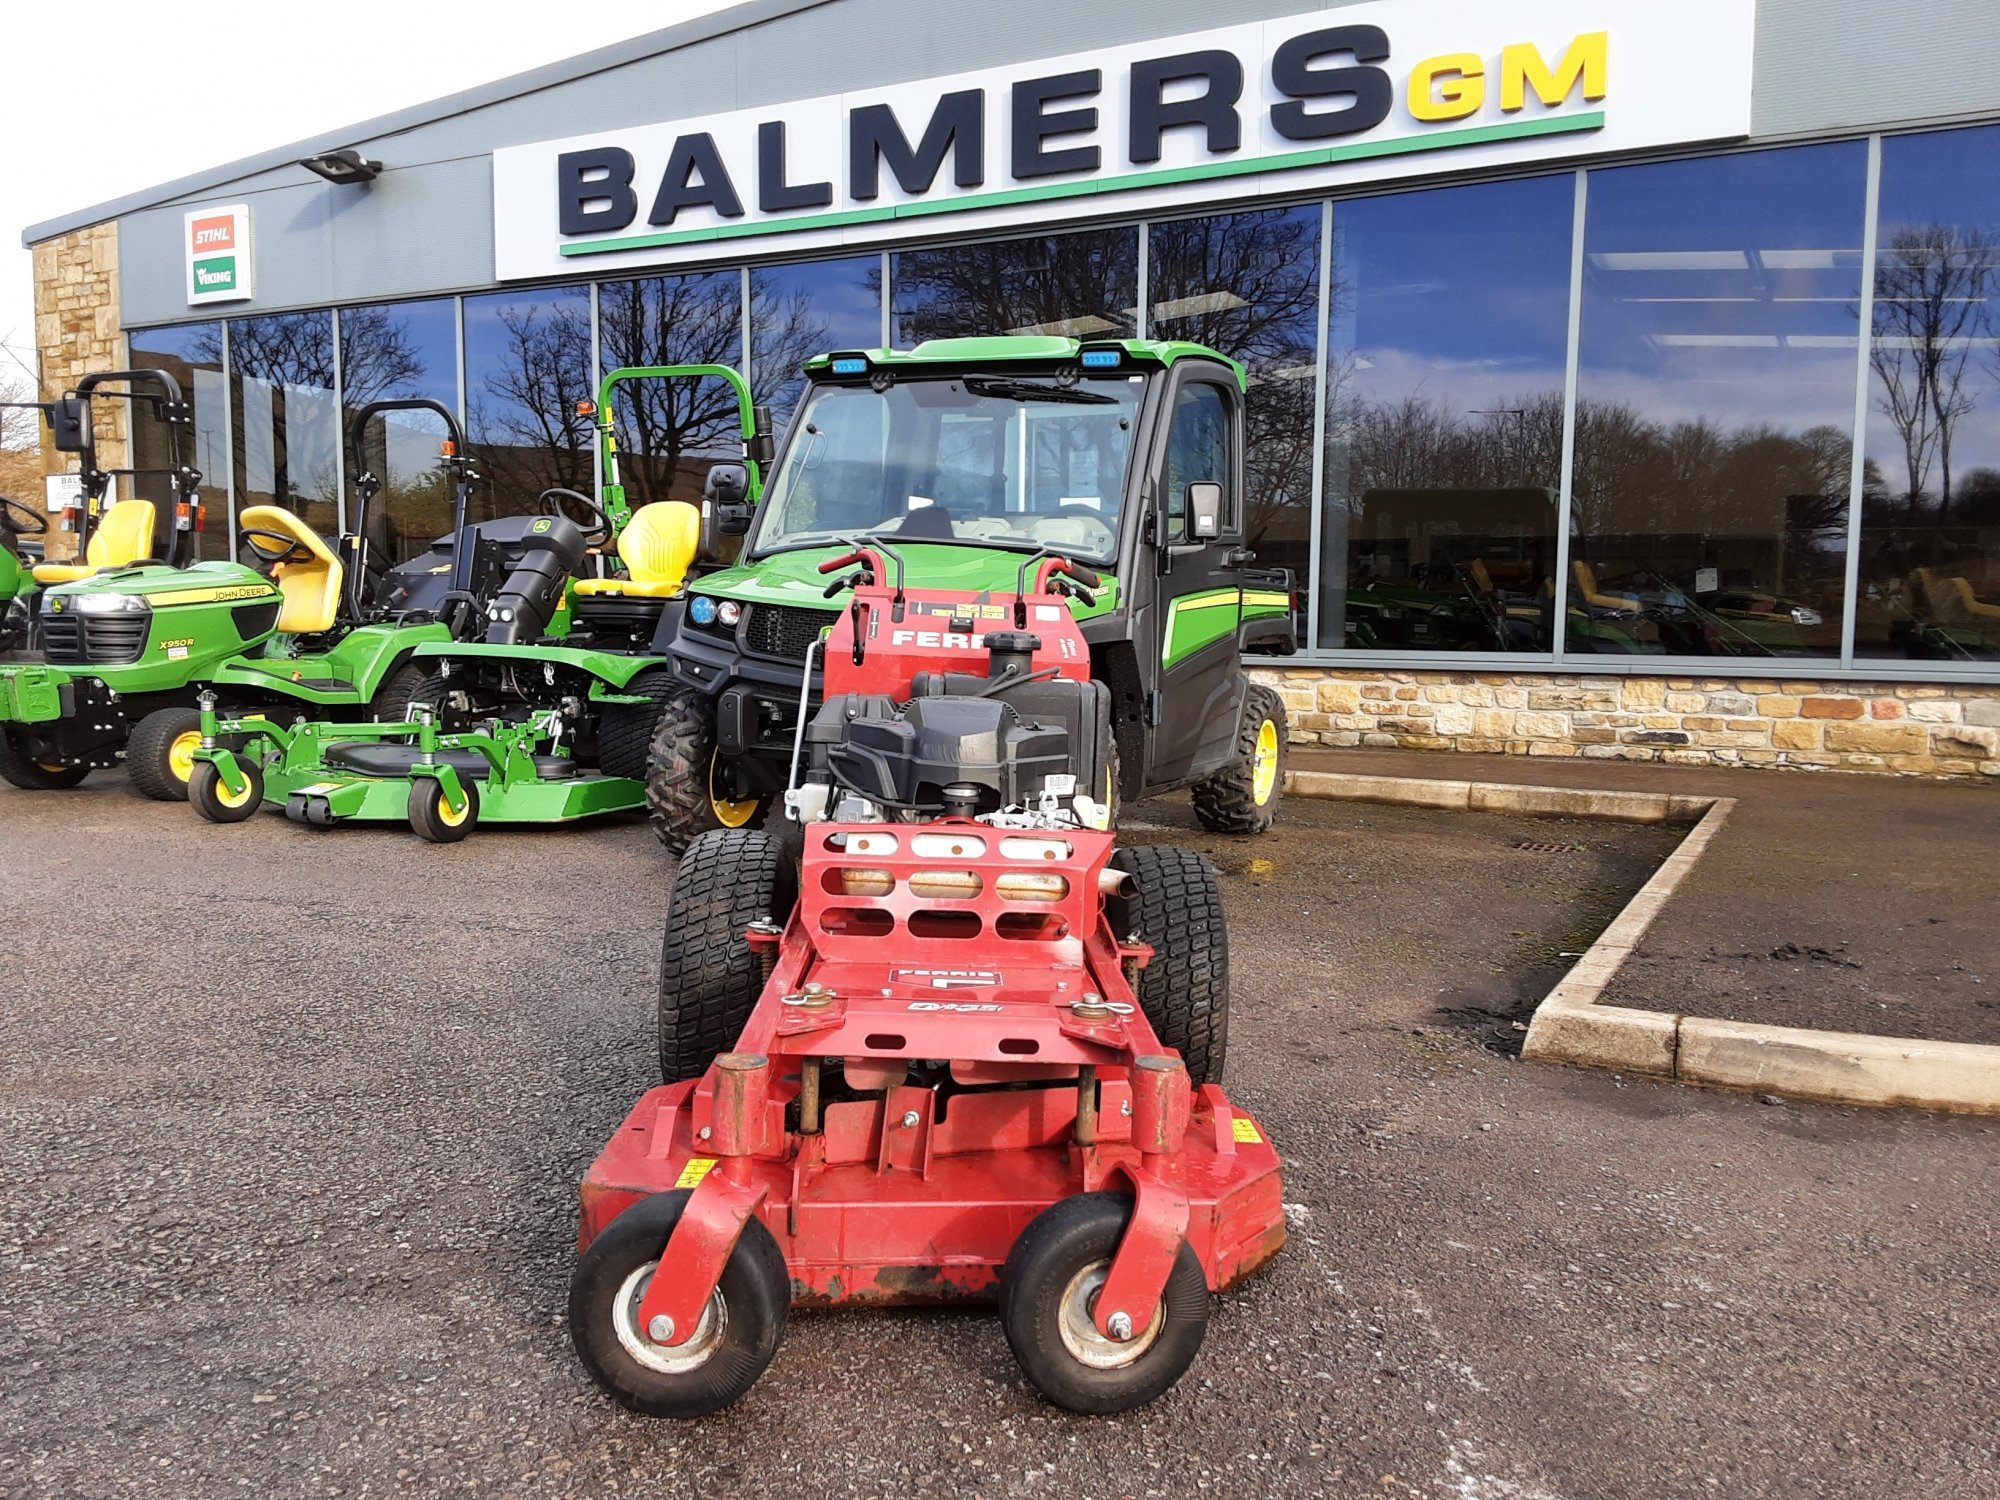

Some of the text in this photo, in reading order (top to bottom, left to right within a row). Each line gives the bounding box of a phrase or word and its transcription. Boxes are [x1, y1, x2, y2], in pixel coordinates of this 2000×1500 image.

[558, 24, 1609, 237] BALMERS GM
[196, 227, 230, 244] STIHL
[198, 271, 231, 285] VIKING
[213, 587, 267, 601] JOHN DEERE
[159, 637, 195, 650] X950R
[892, 630, 985, 650] FERR
